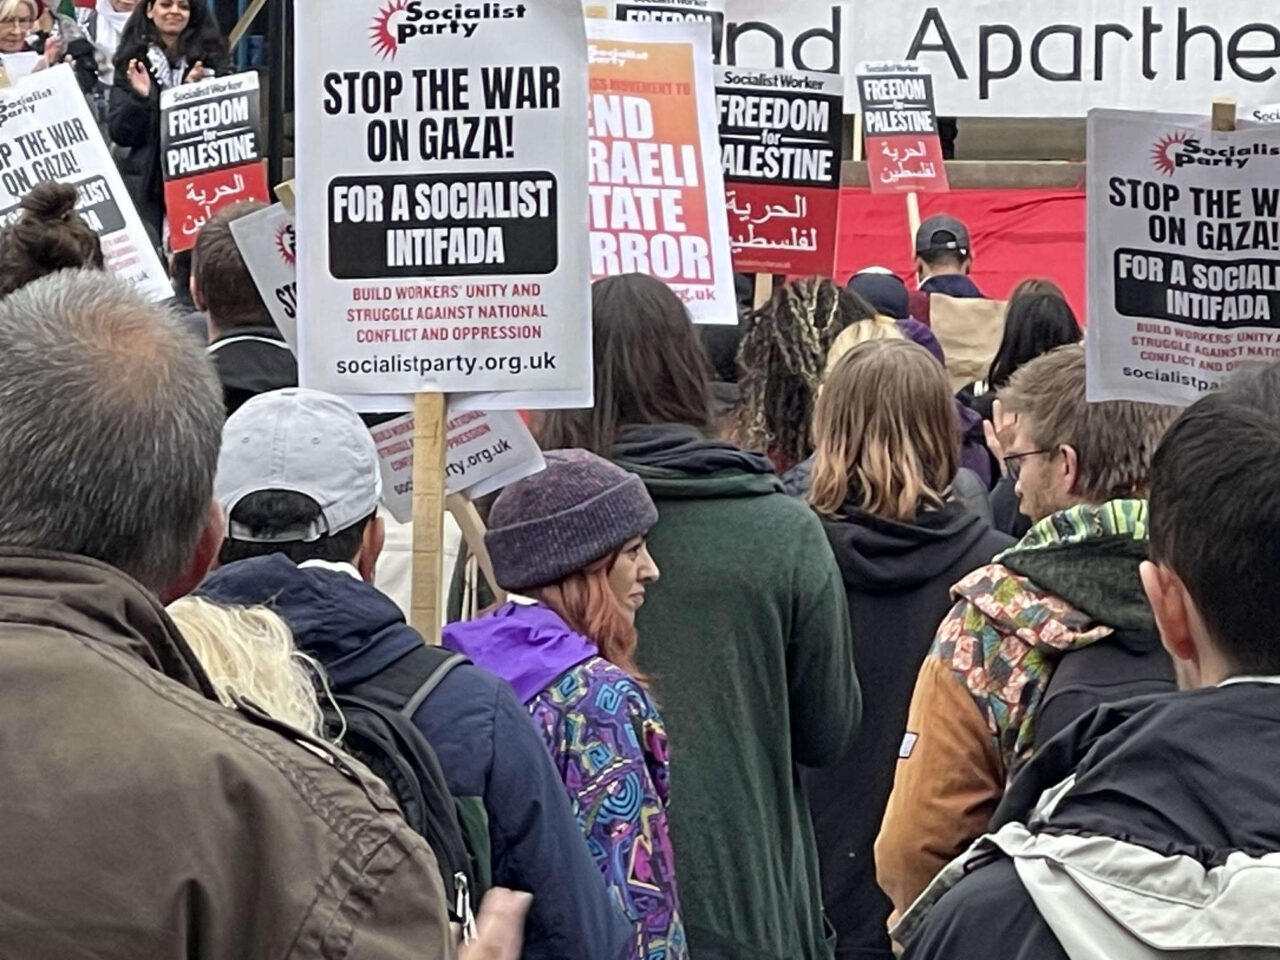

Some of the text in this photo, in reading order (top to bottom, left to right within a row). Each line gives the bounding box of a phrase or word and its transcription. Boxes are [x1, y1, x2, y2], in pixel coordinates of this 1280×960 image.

[405, 1, 527, 22] Socialist
[726, 5, 842, 76] nd
[323, 66, 561, 115] STOP THE WAR
[724, 71, 824, 90] Socialist Worker
[863, 78, 926, 100] FREEDOM
[168, 96, 249, 137] FREEDOM
[716, 94, 829, 133] FREEDOM
[865, 110, 934, 133] PALESTINE
[14, 127, 51, 161] THE
[47, 117, 89, 154] WAR
[167, 132, 258, 176] PALESTINE
[367, 115, 515, 162] ON GAZA!
[761, 129, 781, 146] for
[881, 141, 927, 161] الحرية
[589, 140, 699, 188] RAELI
[721, 143, 834, 182] ALESTINE
[1, 166, 32, 198] ON
[186, 173, 245, 205] الحرية
[1108, 177, 1180, 213] STOP
[1189, 187, 1242, 219] THE
[334, 180, 553, 223] FOR A SOCIALIST
[589, 185, 687, 232] TATE
[385, 226, 506, 267] INTIFADA
[1149, 214, 1280, 252] ON GAZA!
[589, 231, 712, 280] RROR
[1118, 253, 1164, 284] FOR
[1170, 259, 1188, 287] A
[353, 287, 392, 301] BUILD
[466, 284, 508, 299] UNITY
[512, 283, 541, 298] AND
[1165, 289, 1271, 322] INTIFADA
[347, 304, 548, 322] STRUGGLE AGAINST NATIONAL
[356, 325, 542, 343] CONFLICT AND OPPRESSION
[1131, 336, 1191, 353] STRUGGLE
[1194, 344, 1244, 358] AGAINST
[1136, 322, 1172, 335] BUILD
[1236, 331, 1272, 344] UNITY
[336, 352, 557, 376] socialistparty.org.uk
[1140, 350, 1196, 367] CONFLICT
[1198, 361, 1223, 373] AND
